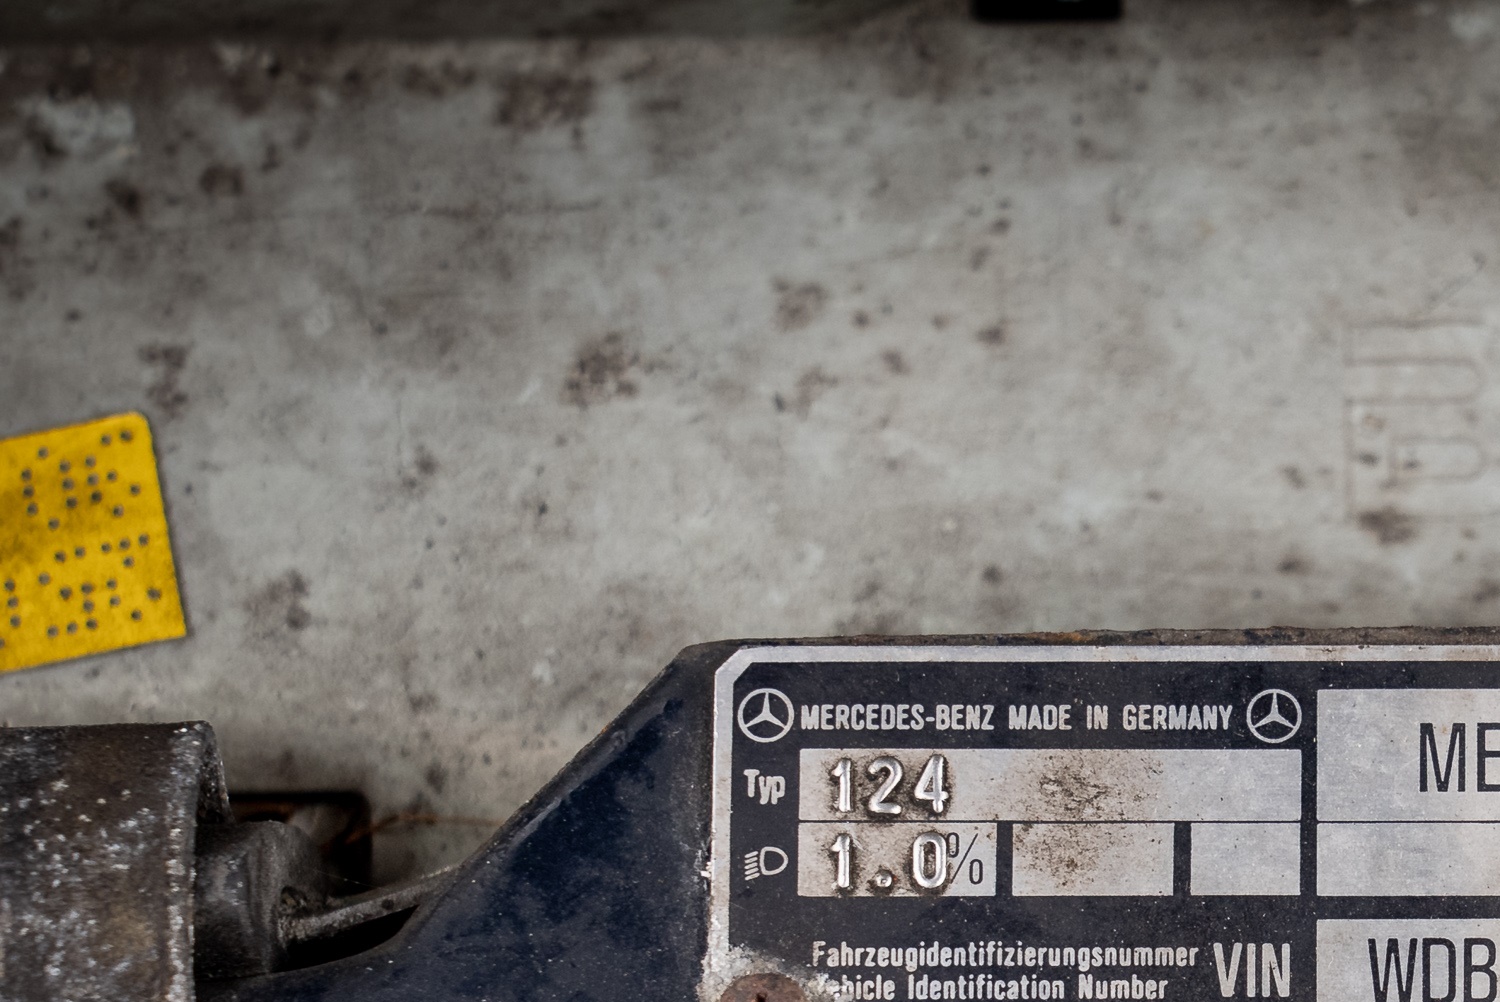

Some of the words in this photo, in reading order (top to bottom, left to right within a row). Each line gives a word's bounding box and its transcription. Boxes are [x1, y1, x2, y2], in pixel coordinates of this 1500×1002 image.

[800, 703, 995, 731] MERCEDES-BENZ
[1008, 704, 1072, 731] MADE
[1086, 704, 1109, 730] IN
[1122, 704, 1233, 731] GERMANY
[743, 768, 787, 805] Typ
[831, 754, 950, 814] 124
[812, 940, 1199, 971] Fahrzeugidentifizierungsnummer
[1213, 942, 1291, 998] VIN
[815, 973, 896, 1001] hicle
[907, 973, 1065, 1001] Identification
[1078, 973, 1168, 1000] Number
